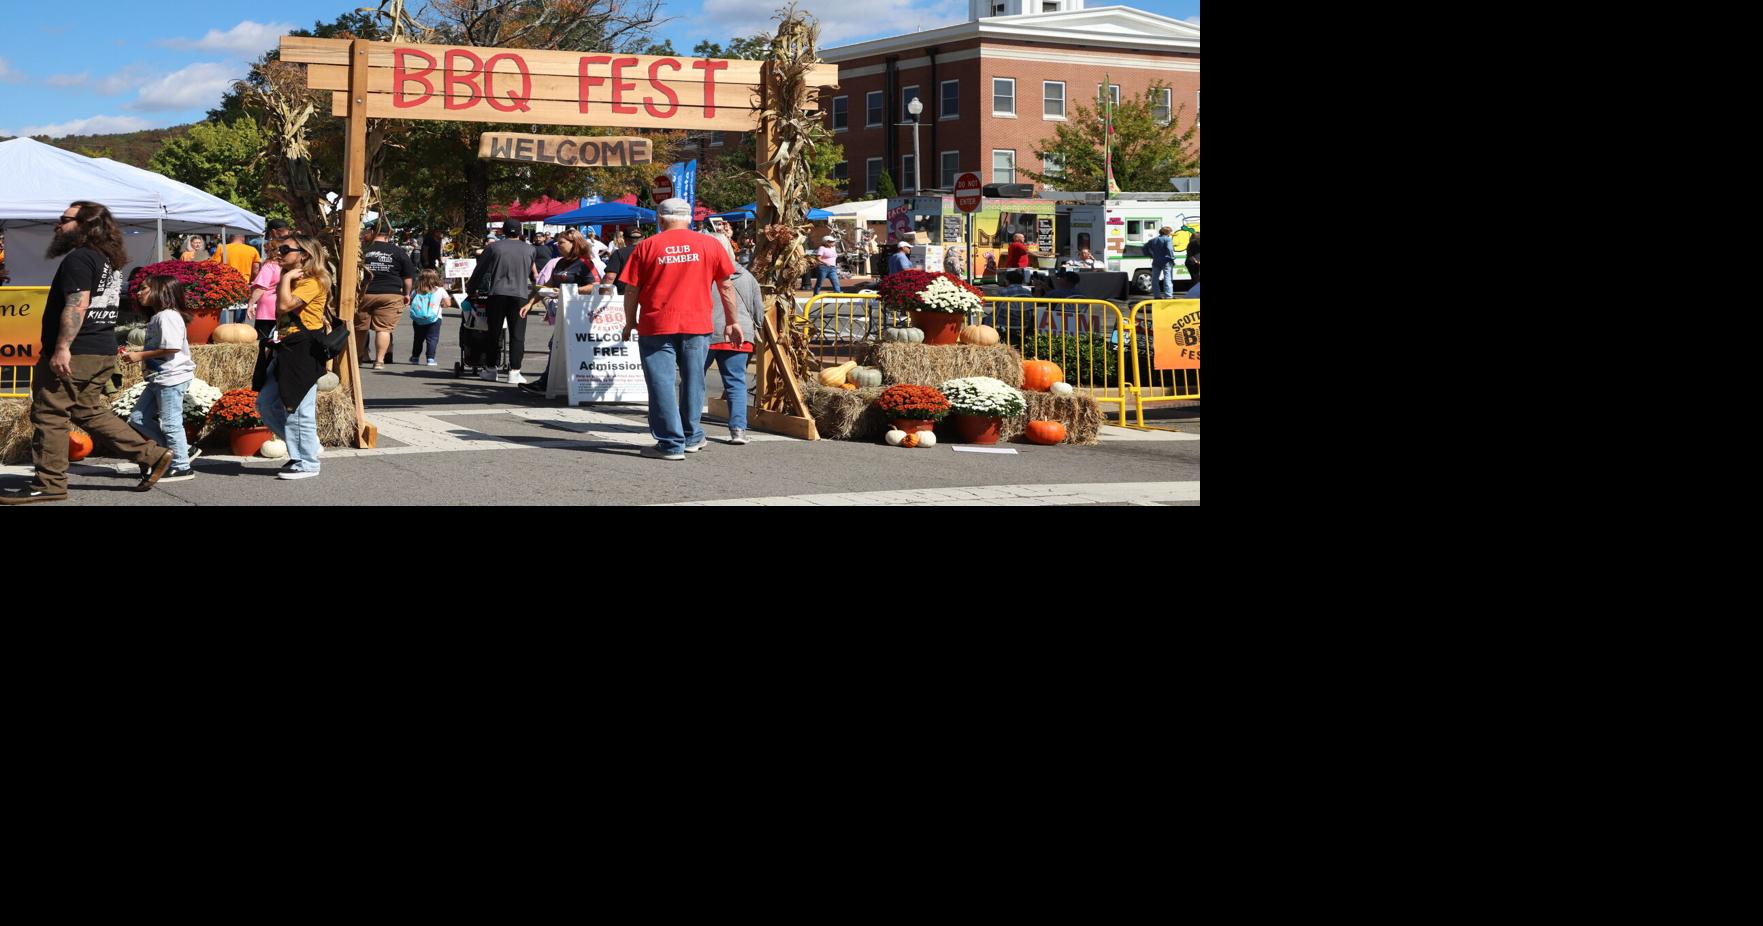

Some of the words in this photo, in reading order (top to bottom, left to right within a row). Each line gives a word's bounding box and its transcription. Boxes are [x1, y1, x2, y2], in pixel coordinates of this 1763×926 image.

[393, 48, 531, 112] BBQ
[578, 56, 729, 118] FEST
[490, 137, 650, 166] WELCOME
[960, 198, 976, 206] ENTER
[664, 244, 691, 255] CLUB
[657, 252, 700, 265] MEMBER
[1039, 310, 1100, 333] ATM
[576, 332, 640, 342] WELCOE
[0, 344, 32, 357] ON
[593, 346, 629, 357] FREE
[579, 361, 643, 371] Admission
